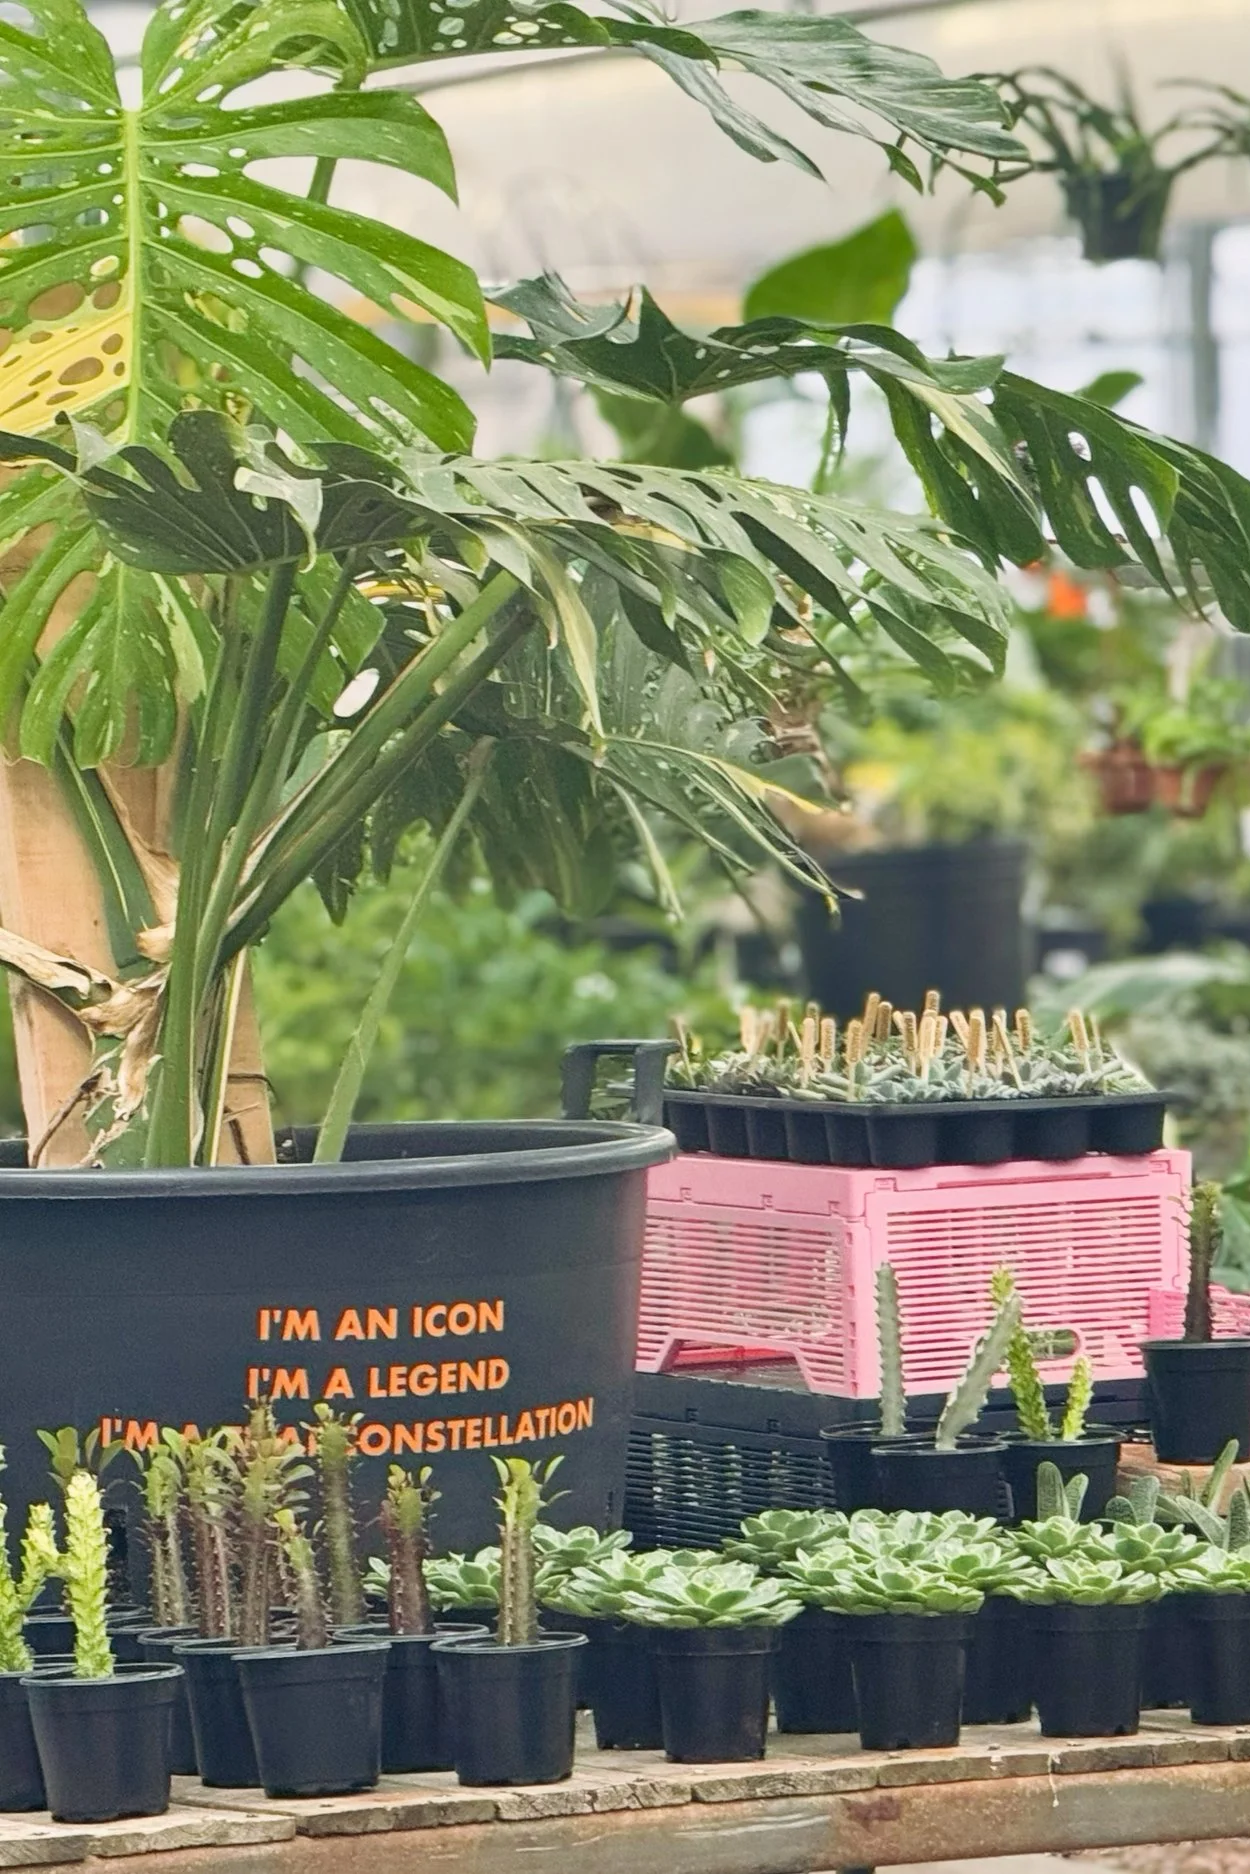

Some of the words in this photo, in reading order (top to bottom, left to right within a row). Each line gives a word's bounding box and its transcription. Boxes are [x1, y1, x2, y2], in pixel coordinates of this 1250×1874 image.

[258, 1309, 318, 1339] I'M
[335, 1307, 396, 1338] AN
[411, 1300, 503, 1336] ICON
[248, 1367, 308, 1398] I'M
[324, 1367, 352, 1398] A
[367, 1358, 508, 1397] LEGEND
[100, 1417, 158, 1449] I'M
[337, 1398, 593, 1454] ONSTELLATION
